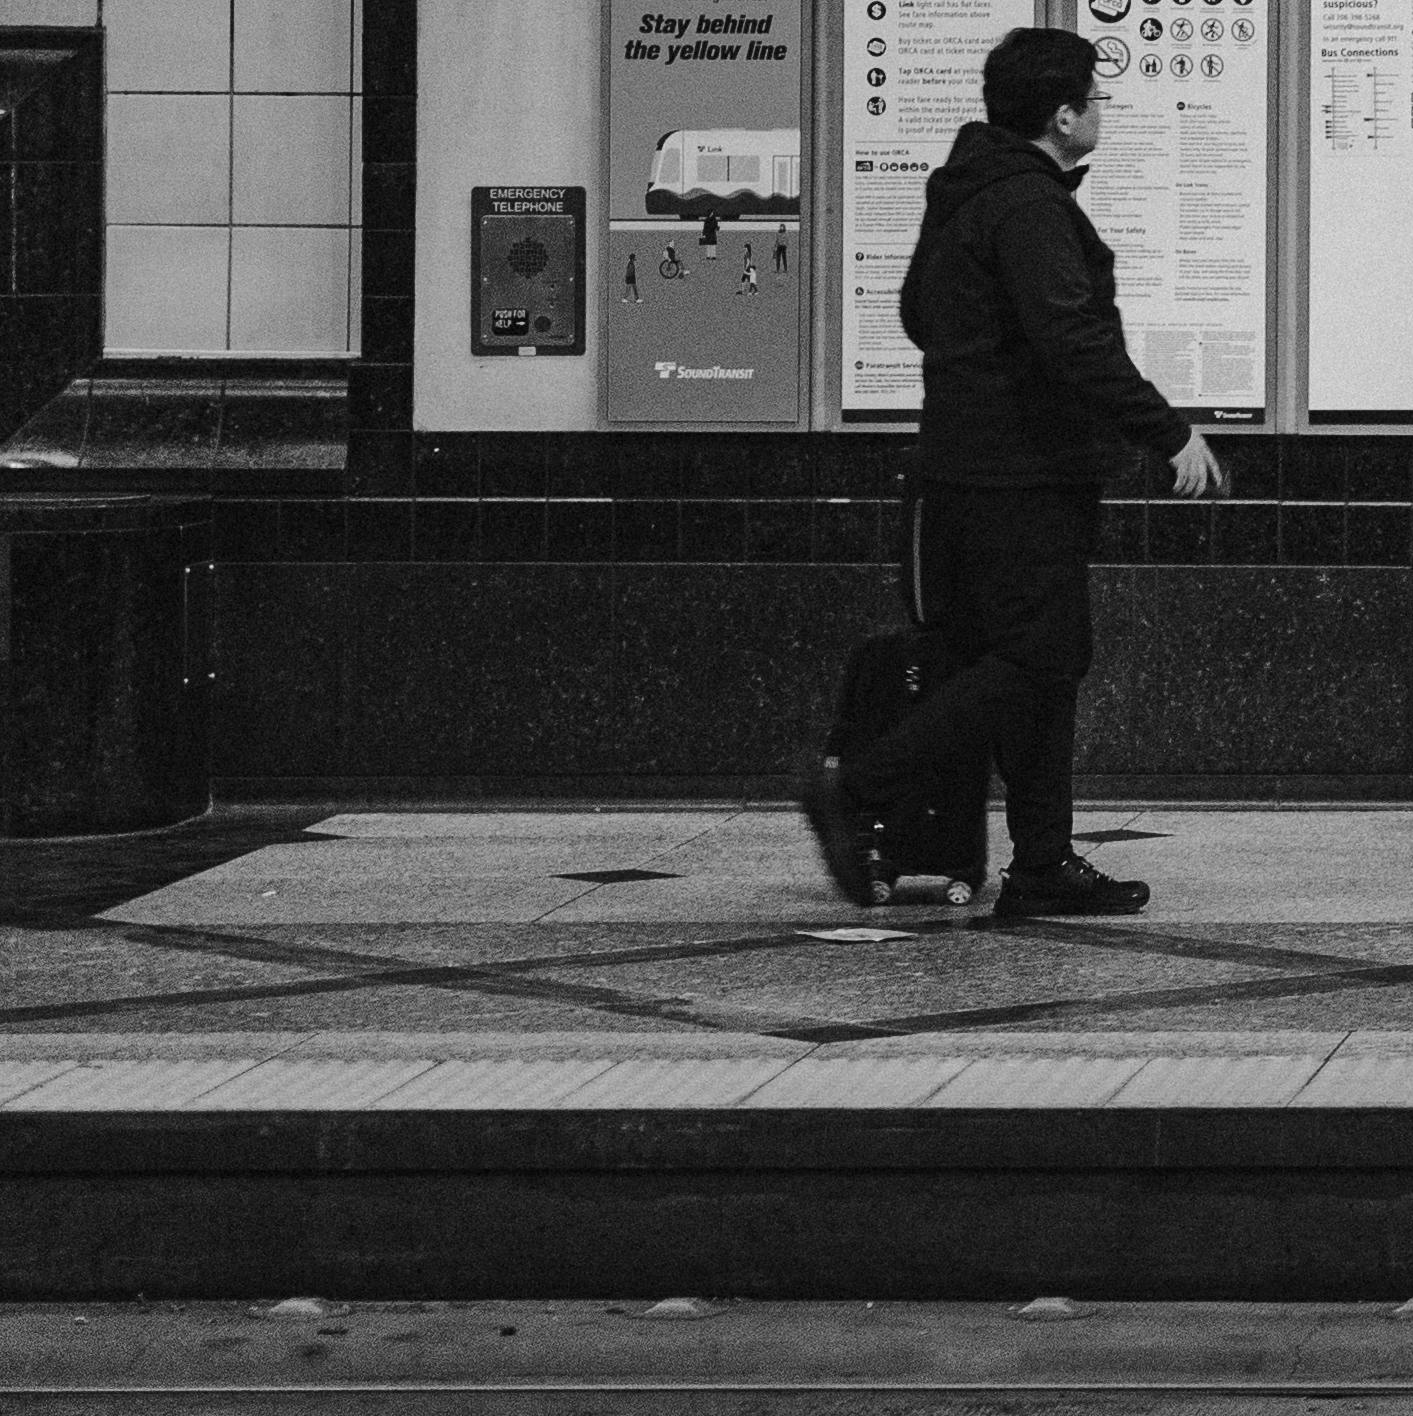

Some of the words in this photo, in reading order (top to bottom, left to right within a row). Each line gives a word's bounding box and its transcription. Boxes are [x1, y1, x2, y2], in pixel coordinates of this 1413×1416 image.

[1323, 0, 1378, 10] suspicious?
[639, 14, 691, 39] Stay
[696, 14, 773, 34] behind
[625, 40, 660, 60] the
[665, 41, 741, 65] yellow
[746, 41, 787, 60] line
[1322, 48, 1338, 57] Bus
[1341, 48, 1399, 57] Connections
[914, 67, 934, 75] ORCA
[936, 67, 952, 75] card
[489, 189, 566, 198] EMERGENCY
[492, 202, 564, 212] TELEPHONE
[495, 319, 512, 328] HELP
